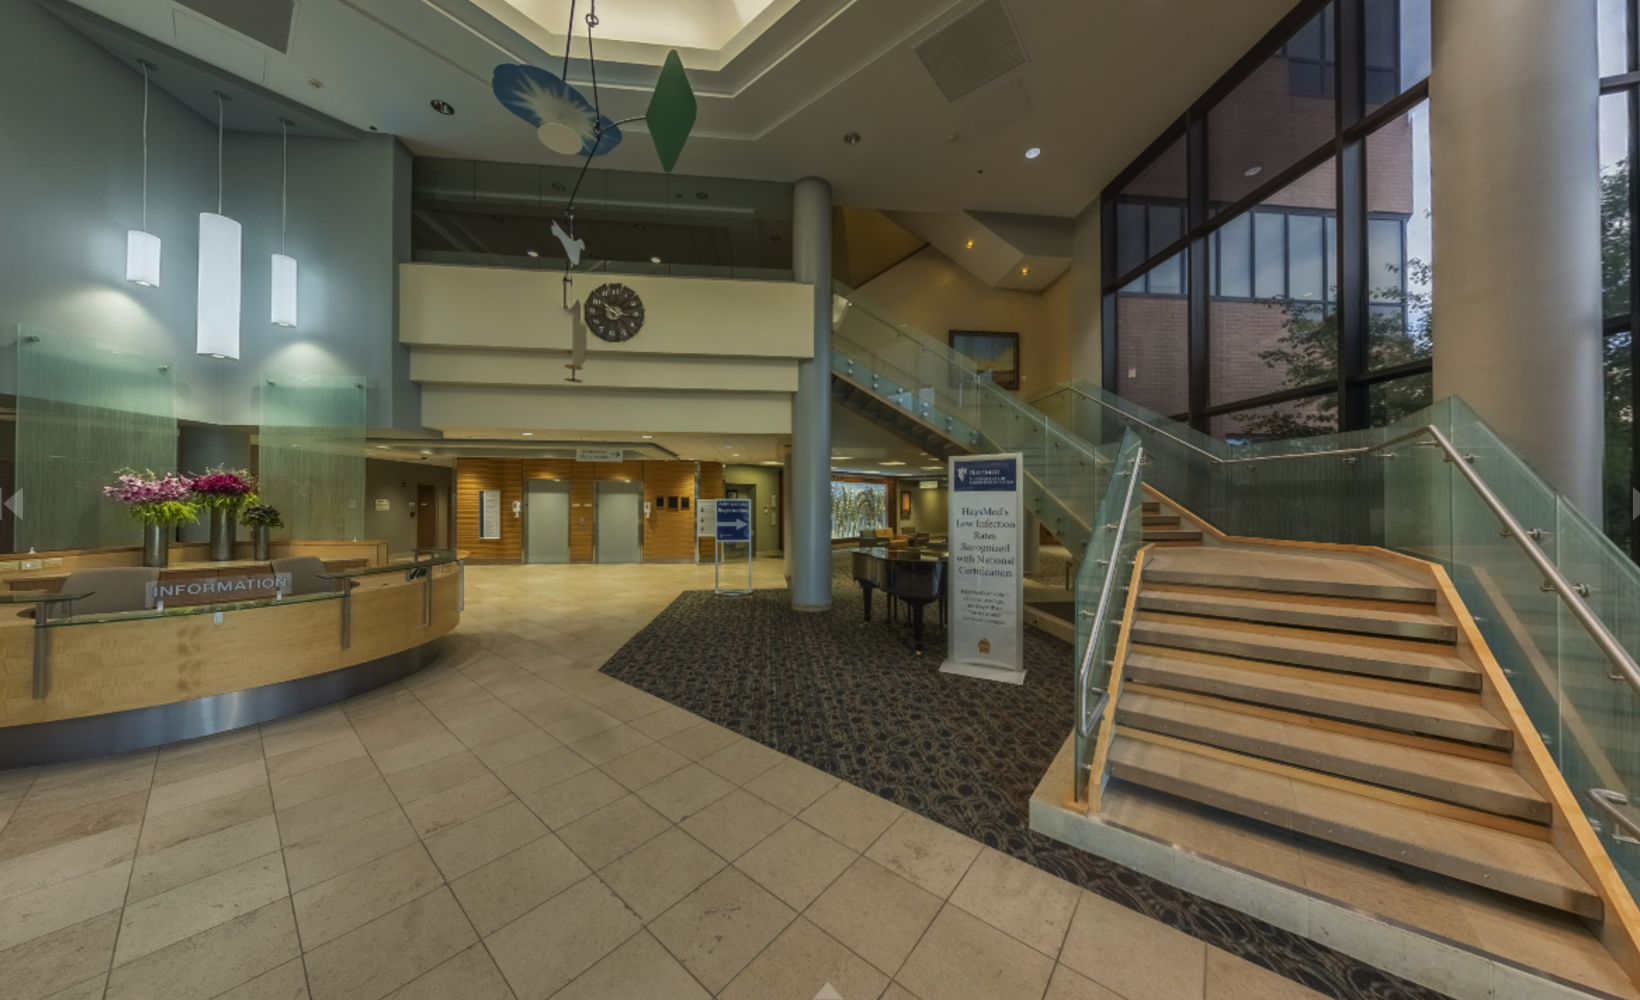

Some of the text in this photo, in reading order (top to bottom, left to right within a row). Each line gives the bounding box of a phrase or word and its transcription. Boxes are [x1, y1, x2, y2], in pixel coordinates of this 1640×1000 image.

[962, 507, 1010, 518] HaysMed's
[956, 519, 1016, 529] Low Infection
[973, 531, 997, 541] Rates
[960, 542, 1010, 554] Recognized
[956, 554, 1015, 566] with National
[958, 566, 1013, 578] Certification
[152, 577, 288, 598] INFORMATION
